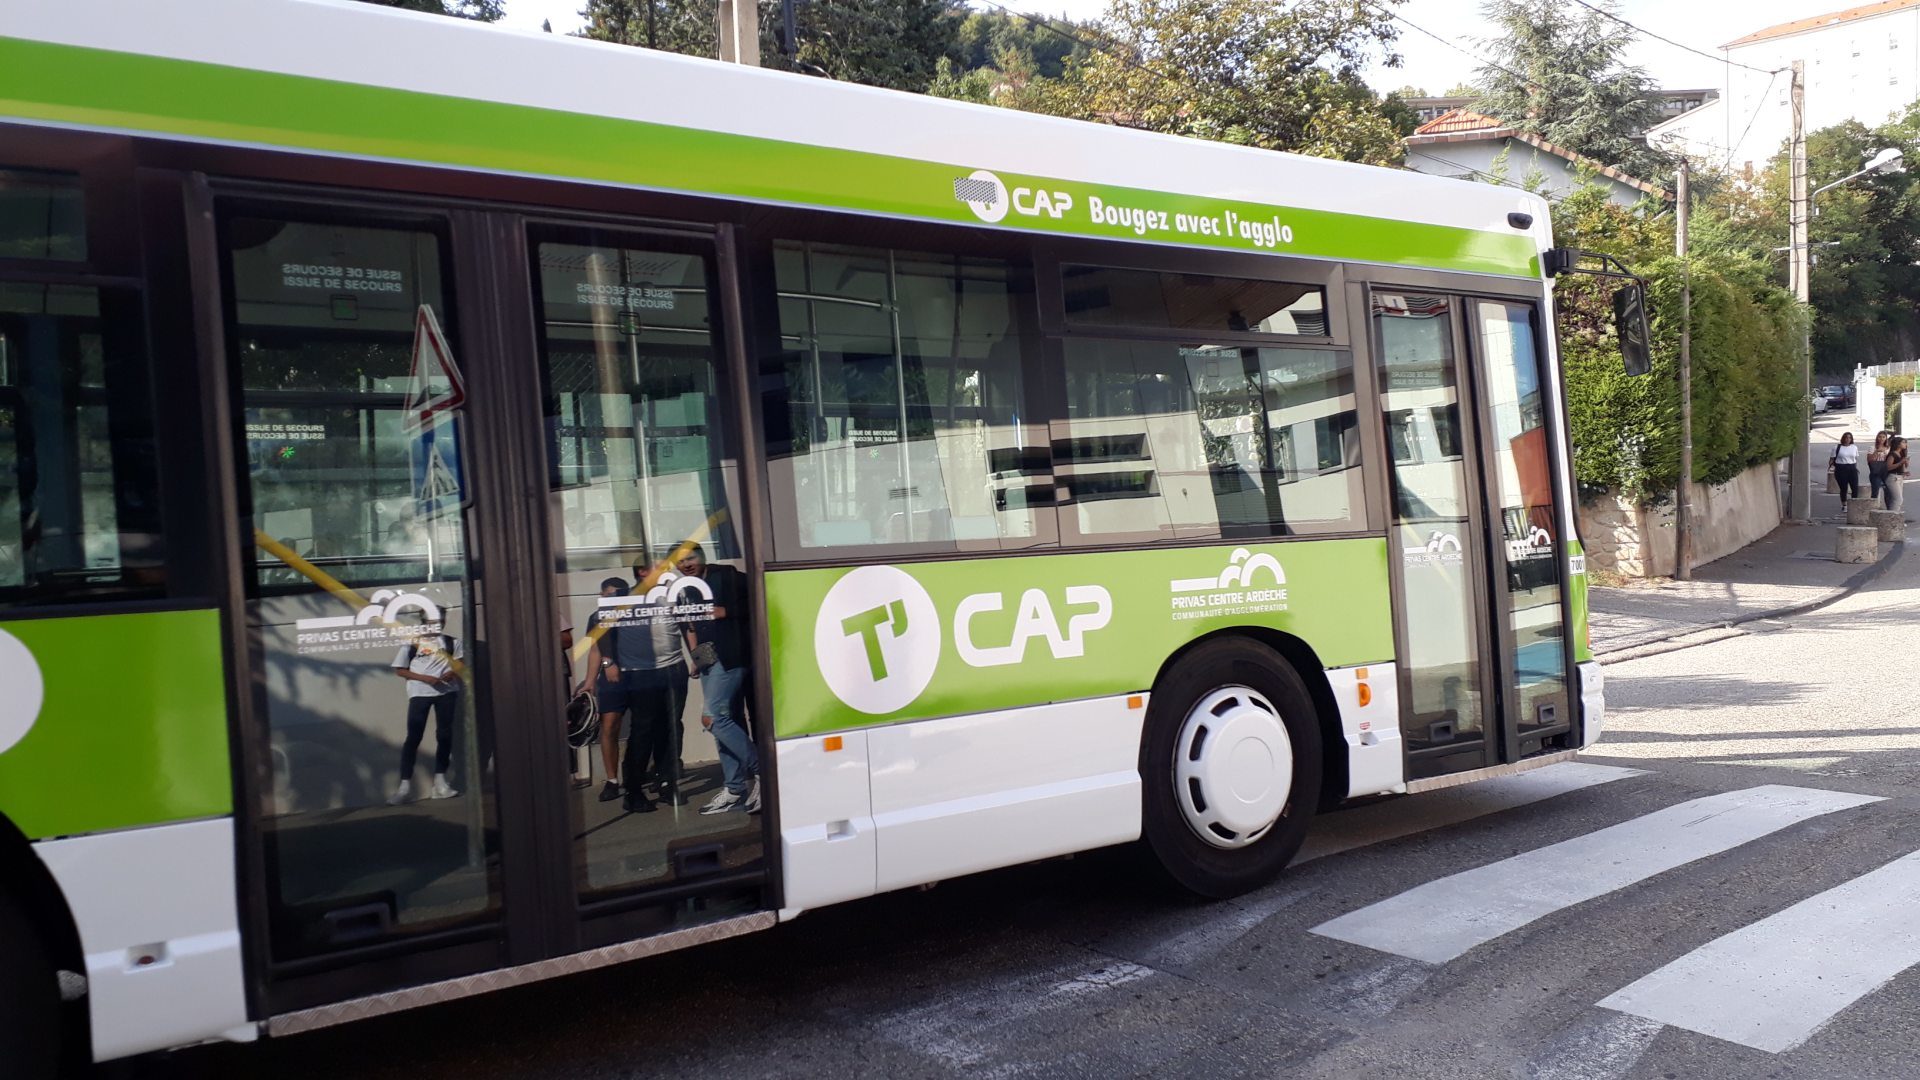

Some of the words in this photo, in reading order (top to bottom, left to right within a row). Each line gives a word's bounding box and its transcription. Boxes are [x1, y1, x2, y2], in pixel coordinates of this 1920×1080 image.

[1012, 187, 1073, 218] CAP
[1088, 195, 1170, 235] Bougez
[1175, 212, 1221, 236] avec
[1225, 210, 1293, 248] l'agglo
[283, 276, 321, 288] ISSUE
[324, 279, 341, 289] DE
[344, 280, 402, 292] SECOURS
[577, 294, 608, 305] ISSUE
[610, 296, 624, 306] DE
[627, 297, 674, 310] SECOURS
[285, 424, 325, 432] SECOURS
[1172, 595, 1206, 609] PRIVAS
[1208, 592, 1244, 606] CENTRE
[1246, 588, 1287, 603] ARDÈCHE
[598, 608, 633, 620] PRIVAS
[634, 606, 670, 618] CENTRE
[672, 602, 714, 615] ARDÈCHE
[953, 585, 1113, 668] CAP
[297, 631, 340, 645] PRIVAS
[342, 627, 386, 641] CENTRE
